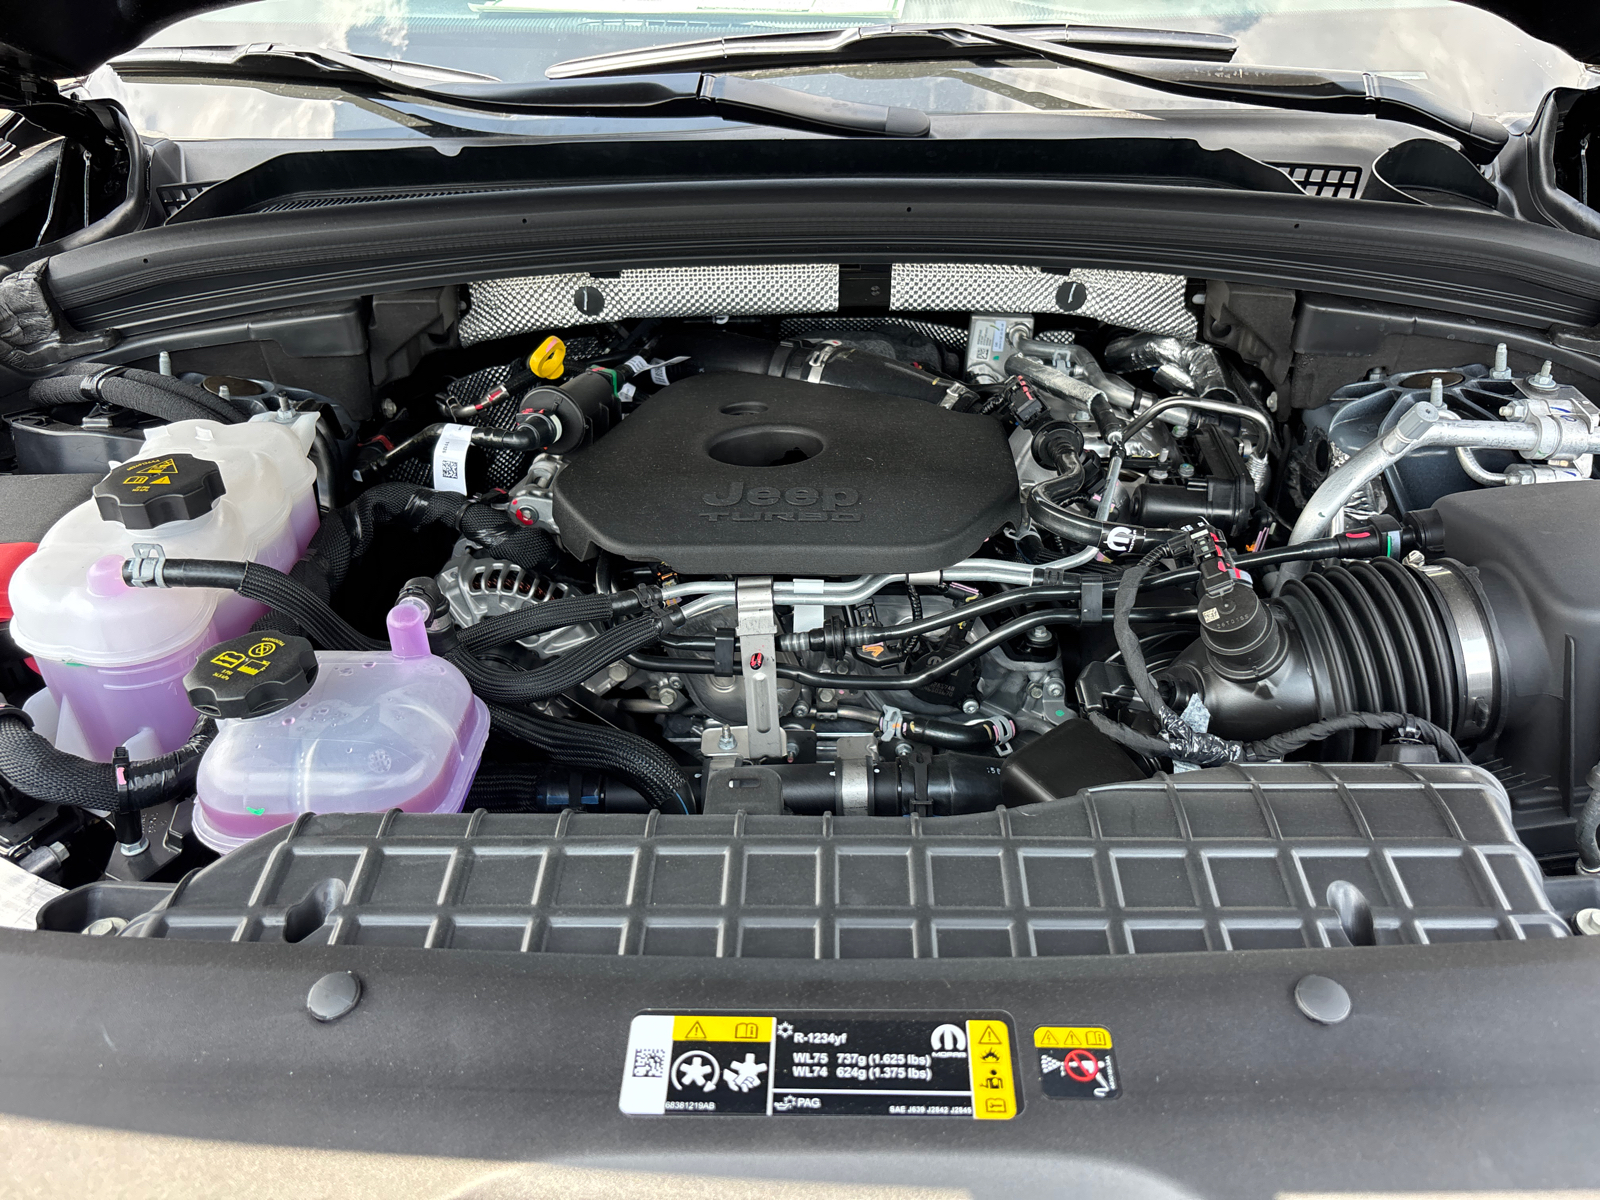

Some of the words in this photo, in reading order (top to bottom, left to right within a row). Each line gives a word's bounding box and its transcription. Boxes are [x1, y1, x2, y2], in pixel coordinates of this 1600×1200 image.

[702, 482, 860, 512] Jeep
[698, 511, 862, 522] TURBO
[794, 1032, 848, 1046] R-1234yf
[793, 1052, 829, 1064] WL75
[836, 1053, 867, 1067] 737g
[869, 1053, 905, 1067] (1.625
[908, 1053, 932, 1067] lbs)
[792, 1066, 828, 1078] WL74
[836, 1066, 867, 1080] 624g
[869, 1066, 905, 1080] (1.375
[908, 1067, 932, 1081] lbs)
[665, 1101, 716, 1111] 68381219AB
[796, 1097, 822, 1109] PAG
[889, 1105, 906, 1114] SAE
[907, 1105, 926, 1114] J639
